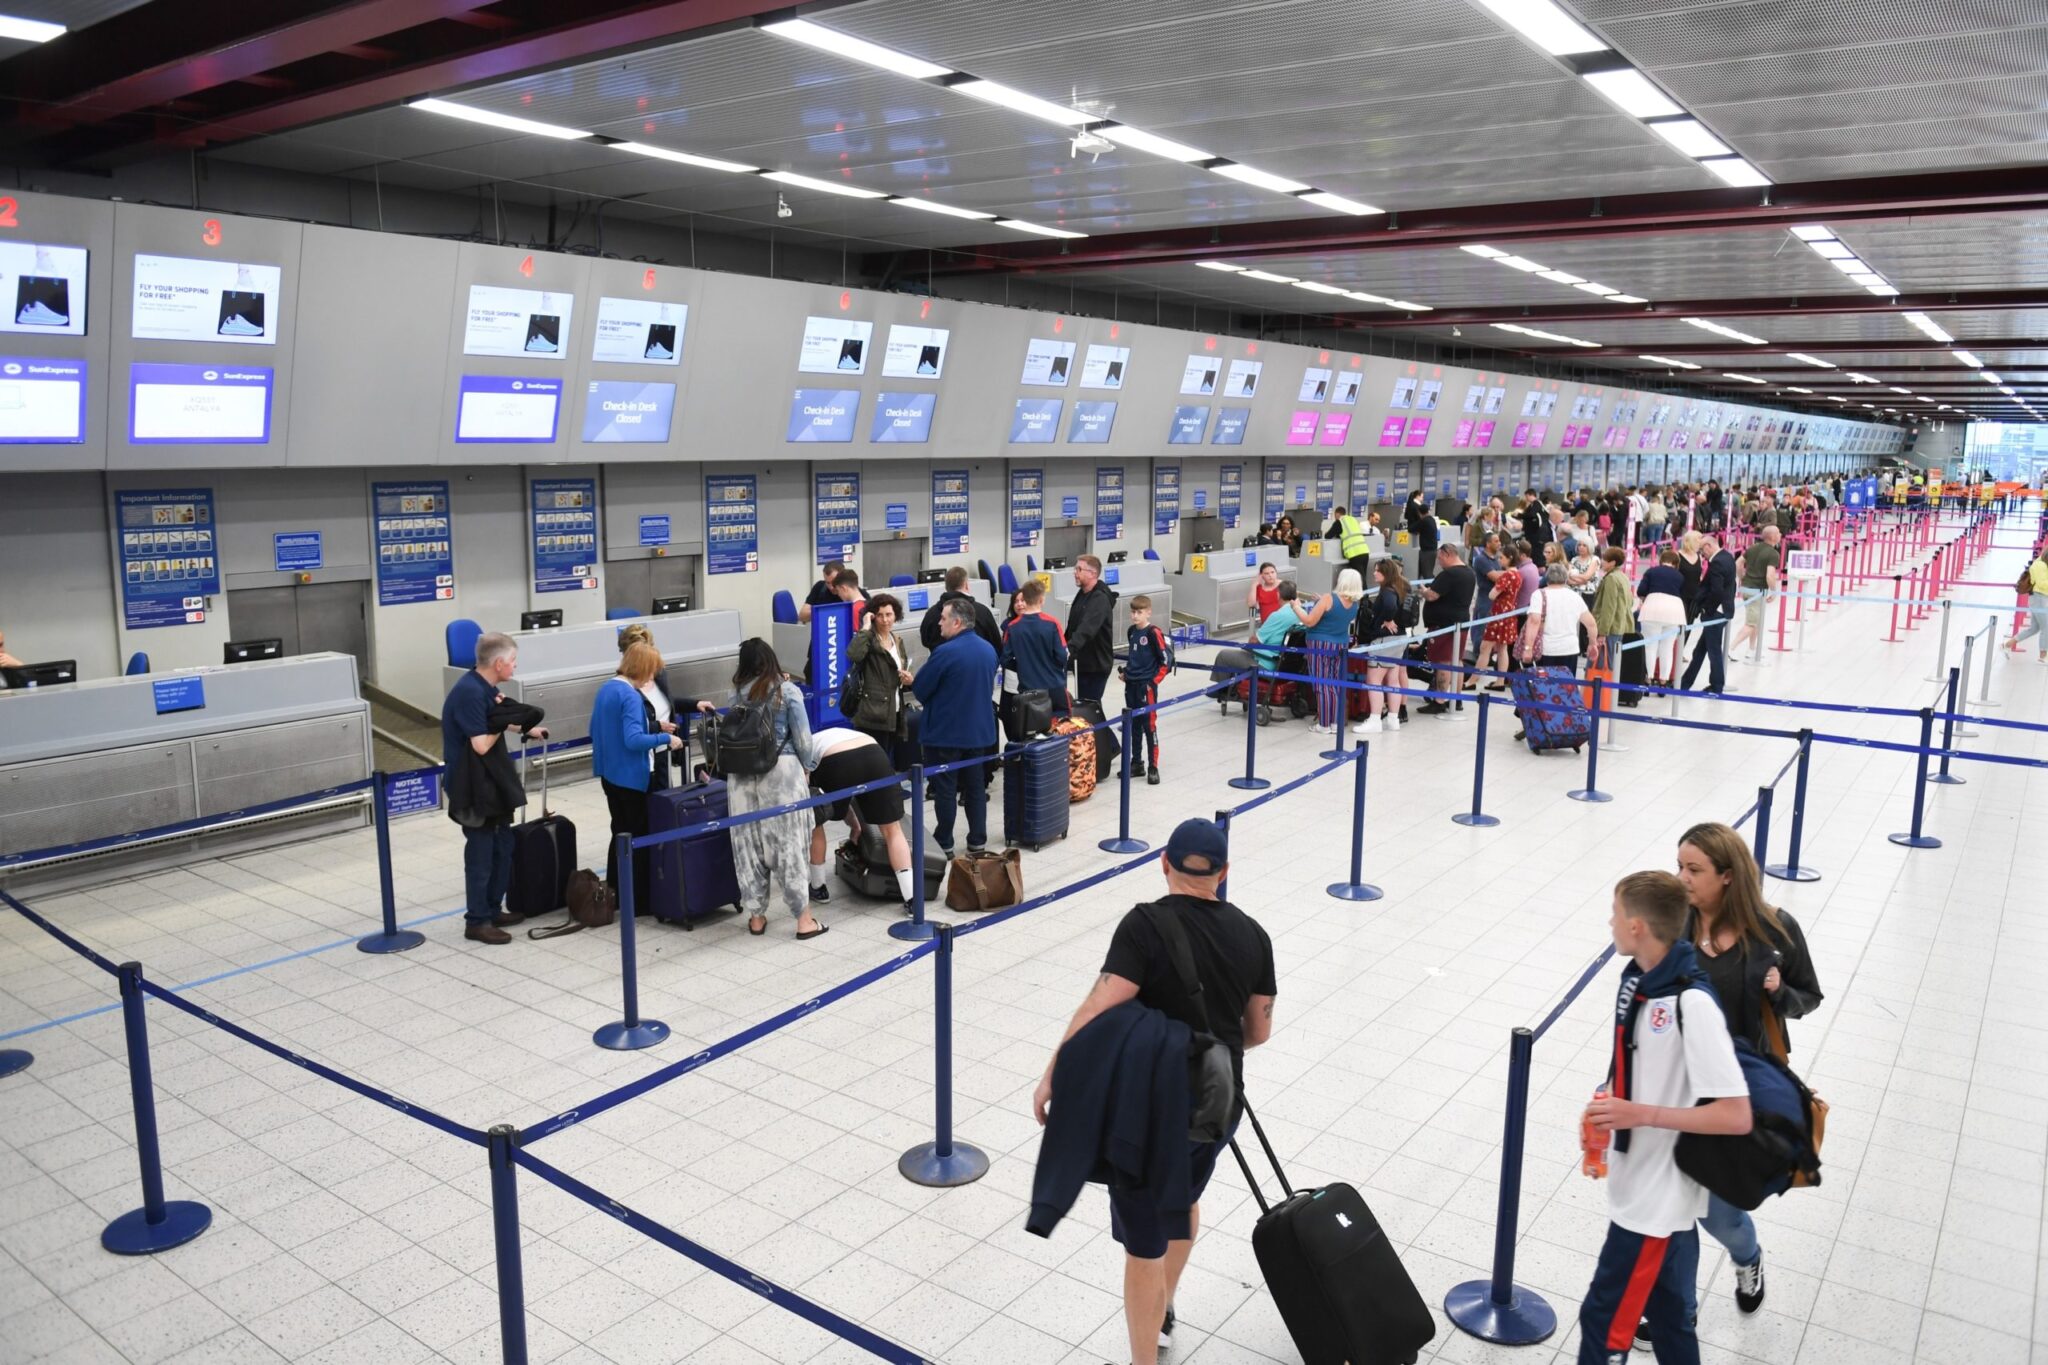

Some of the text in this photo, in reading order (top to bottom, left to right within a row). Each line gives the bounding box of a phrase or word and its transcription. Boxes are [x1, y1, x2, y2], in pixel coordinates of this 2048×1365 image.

[0, 196, 19, 228] 2
[203, 218, 222, 246] 3
[519, 255, 534, 278] 4
[642, 268, 656, 290] 5
[140, 283, 209, 295] FLY YOUR SHOPPING
[139, 291, 152, 300] FOR
[28, 365, 79, 376] SunExpress
[223, 372, 266, 381] SunExpress
[603, 401, 657, 412] Check-in Desk
[804, 406, 845, 416] Check-in Desk
[616, 413, 642, 424] Closed
[885, 409, 922, 417] Check-in Desk
[812, 416, 833, 426] Closed
[893, 418, 912, 427] Closed
[377, 484, 444, 495] Important Information
[121, 493, 207, 503] Important Information
[395, 777, 422, 788] NOTICE
[392, 796, 427, 807] before placing
[1617, 976, 1640, 1020] JOM
